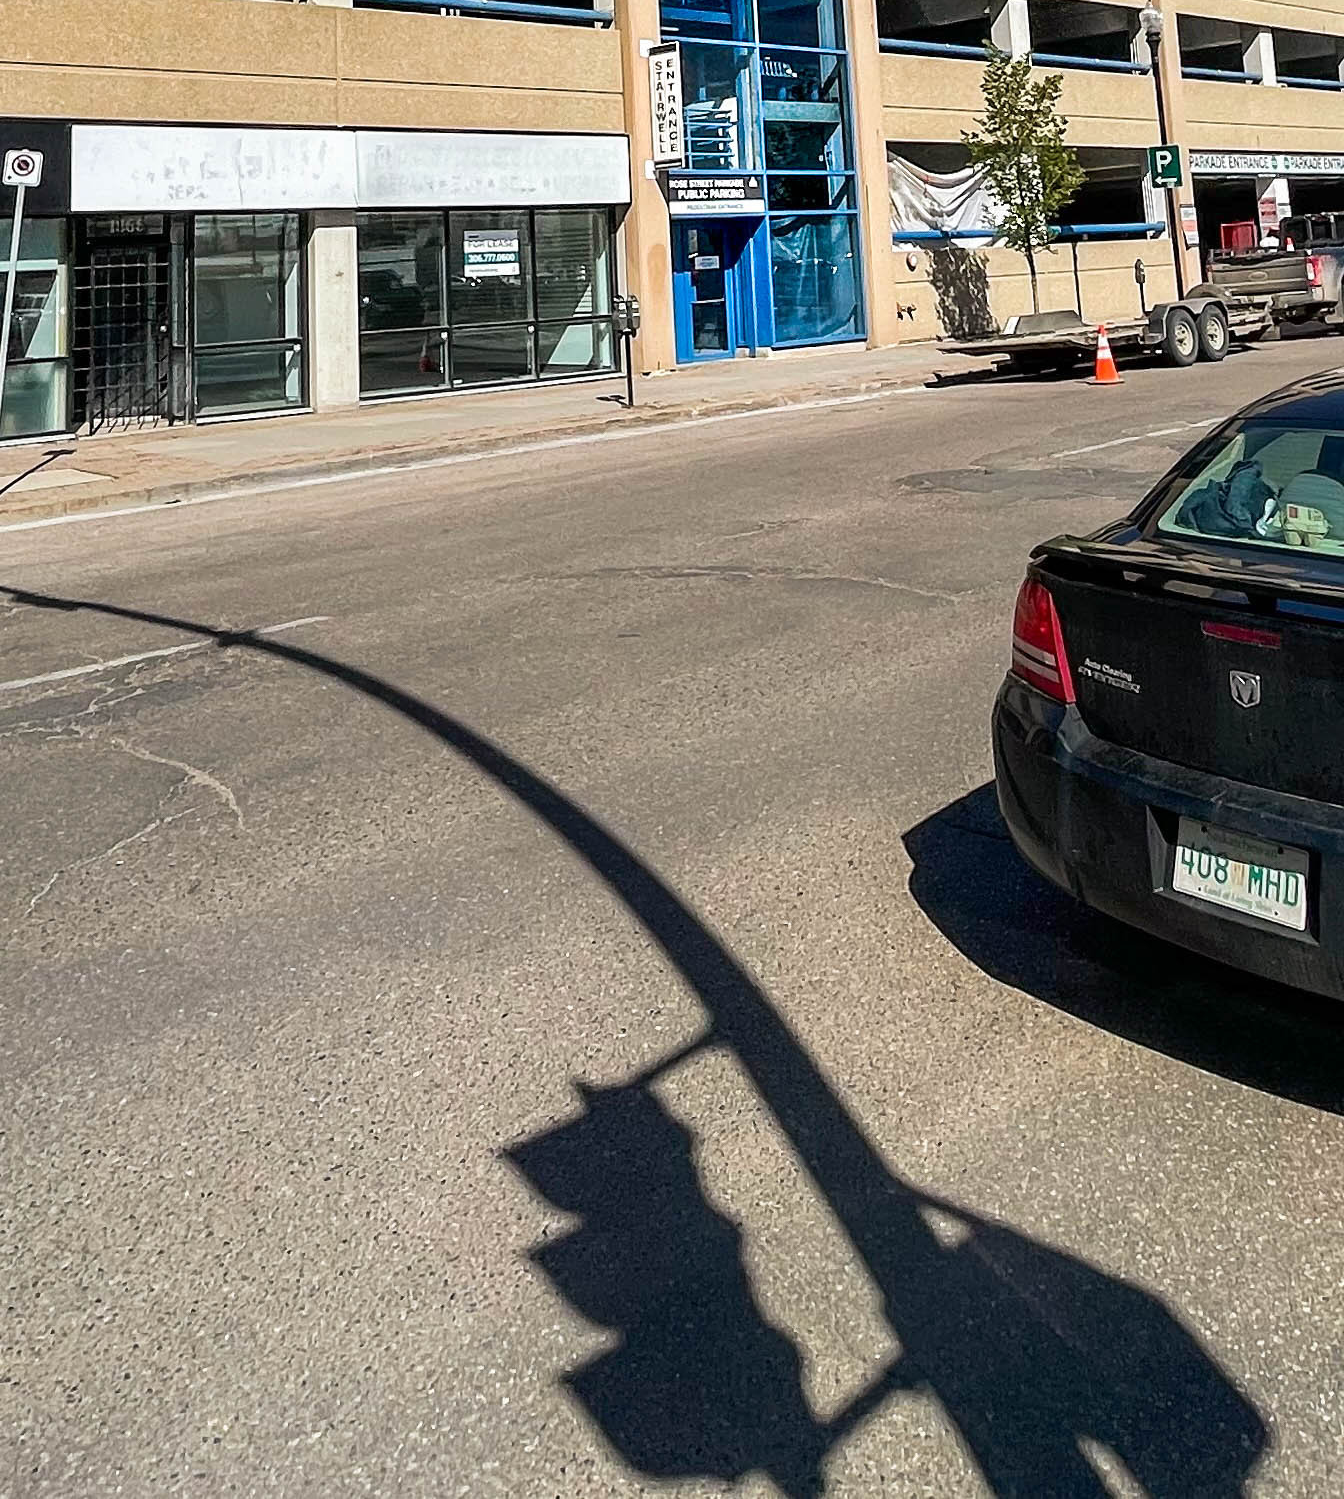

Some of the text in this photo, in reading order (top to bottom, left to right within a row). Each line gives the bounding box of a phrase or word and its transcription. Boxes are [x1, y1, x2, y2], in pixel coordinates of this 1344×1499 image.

[654, 60, 667, 153] STAIRWELL
[666, 58, 678, 152] ENTRANCE
[1156, 150, 1173, 173] P
[1189, 155, 1270, 170] PARKADE ENTRANCE
[1290, 156, 1323, 170] PARKADE
[677, 189, 745, 199] PUBLIC PARKING
[1181, 842, 1229, 884] 408
[1248, 861, 1299, 907] MHD
